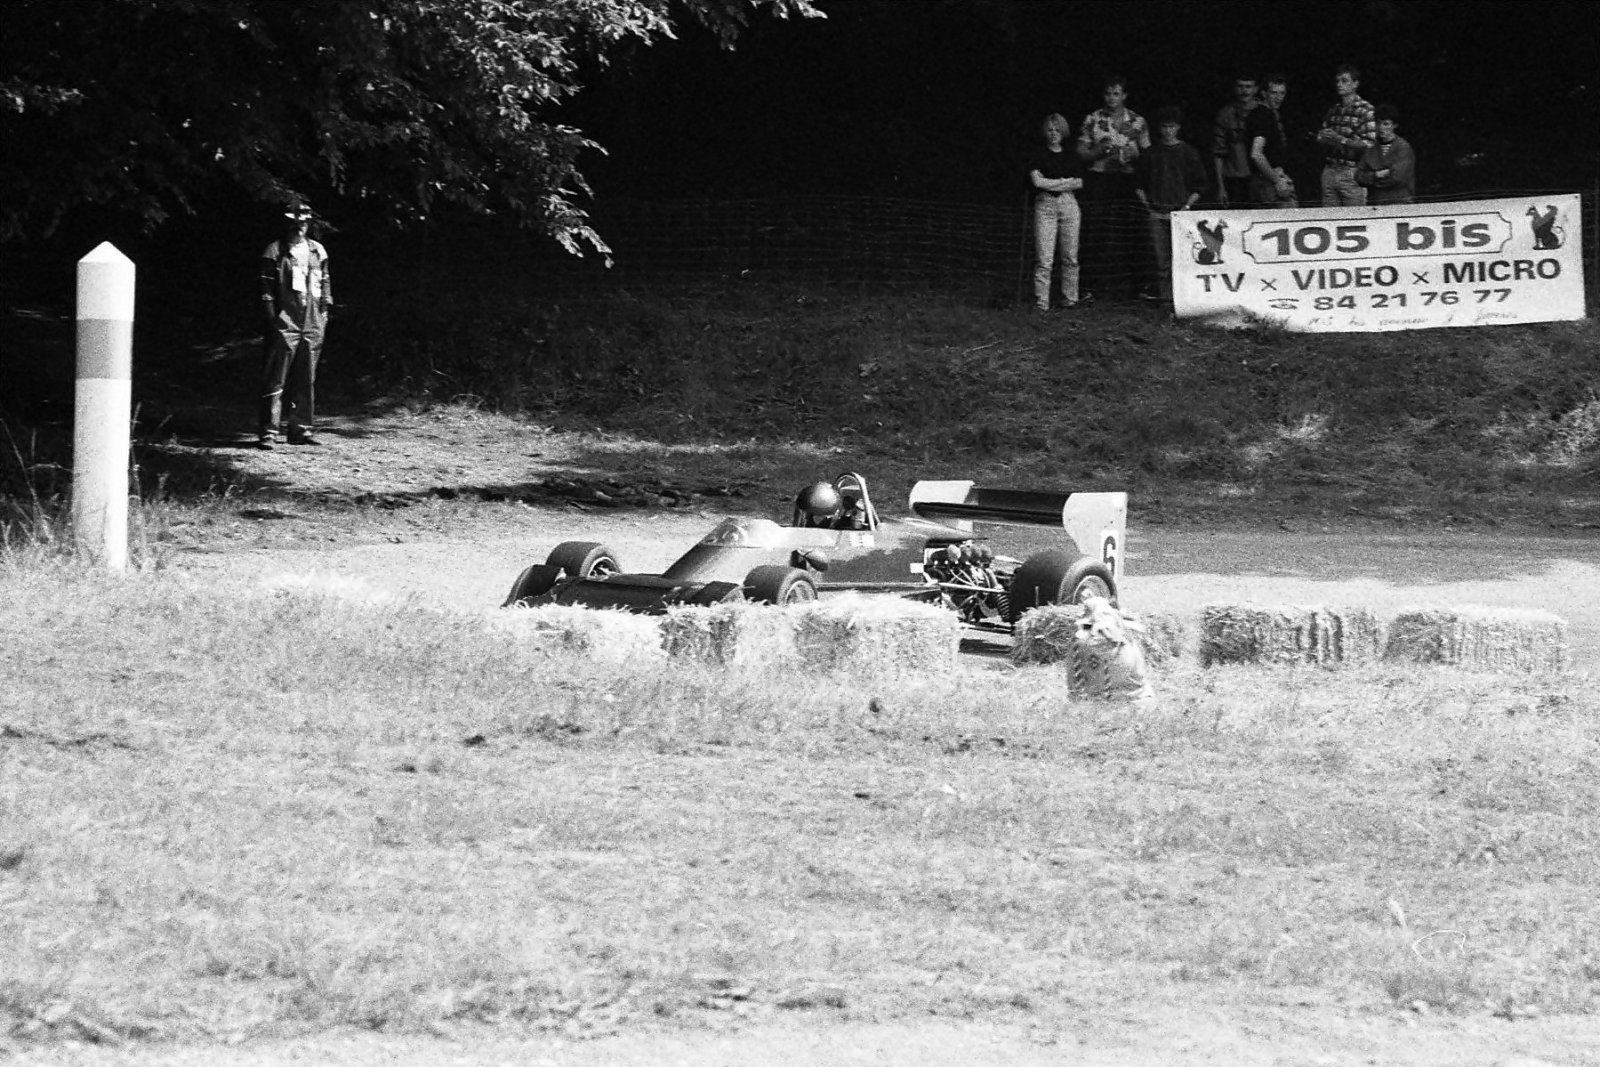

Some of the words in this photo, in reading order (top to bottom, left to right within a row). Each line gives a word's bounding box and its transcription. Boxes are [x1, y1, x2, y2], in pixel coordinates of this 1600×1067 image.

[1260, 225, 1370, 257] 105
[1396, 219, 1492, 252] bis
[1196, 272, 1246, 293] TV
[1291, 265, 1399, 291] VIDEO
[1443, 258, 1562, 285] MICRO
[1313, 295, 1358, 311] 84
[1371, 293, 1408, 310] 21
[1420, 290, 1459, 307] 76
[1474, 288, 1513, 305] 77
[1103, 535, 1116, 577] 6
